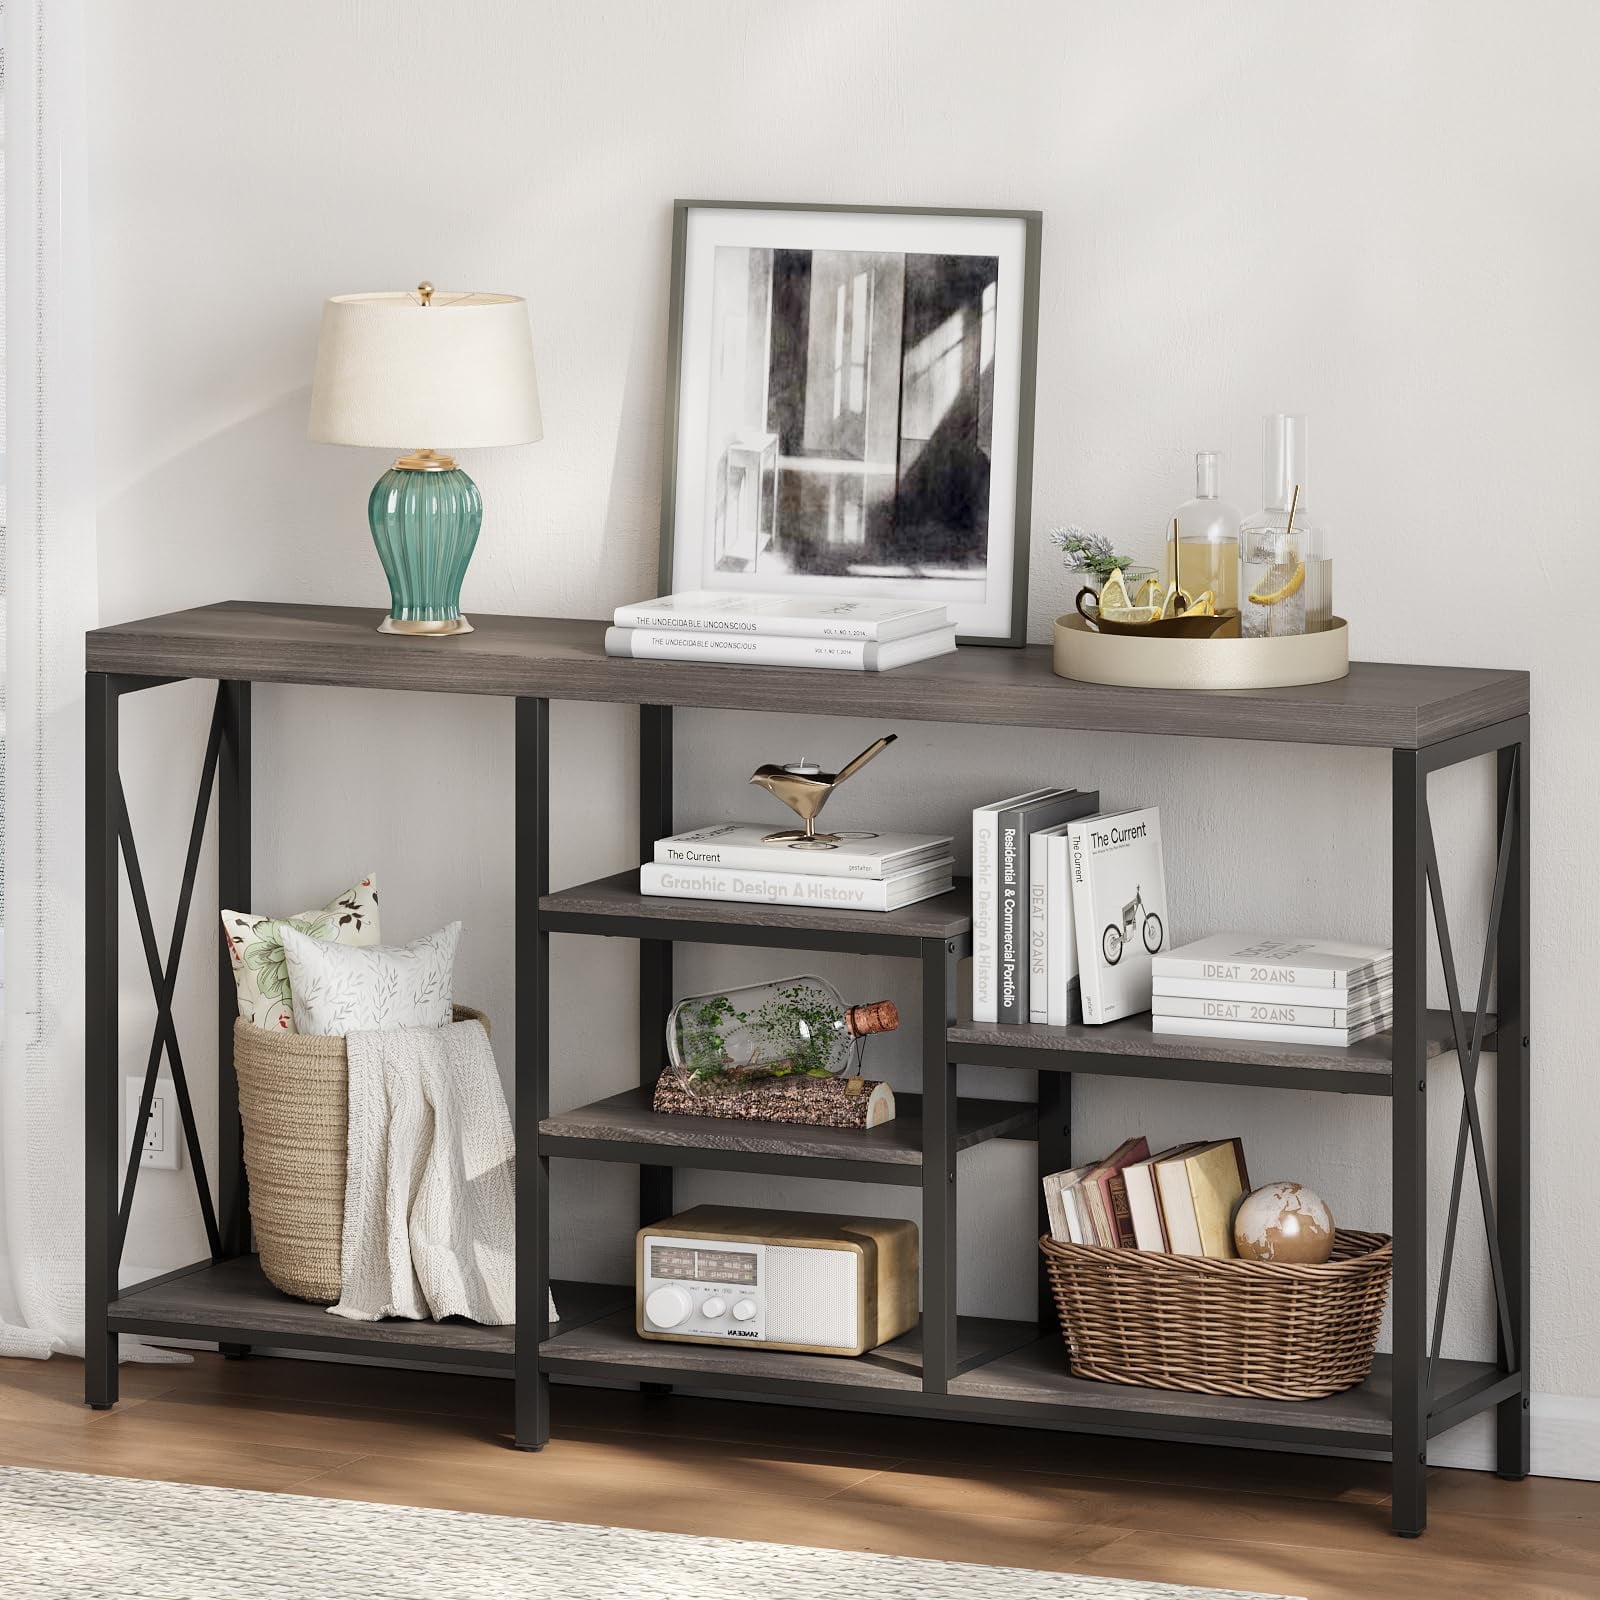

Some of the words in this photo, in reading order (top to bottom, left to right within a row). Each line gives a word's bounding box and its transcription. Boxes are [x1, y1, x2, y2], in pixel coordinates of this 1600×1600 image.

[636, 616, 650, 625] THE
[652, 618, 700, 628] UNDECIDABLE
[703, 620, 757, 631] UNCONSCIOUS
[652, 637, 663, 645] THE
[665, 638, 708, 648] UNDECIDABLE
[710, 640, 757, 650] UNCONSCIOUS
[1072, 835, 1081, 850] The
[1091, 831, 1109, 849] The
[1110, 821, 1147, 844] Current
[667, 849, 684, 860] The
[686, 850, 721, 862] Current
[1004, 828, 1016, 885] Residential
[1073, 852, 1083, 883] Current
[732, 878, 788, 902] Design
[793, 881, 804, 898] A
[808, 884, 865, 902] History
[1004, 888, 1015, 897] &
[1031, 884, 1045, 921] IDEAT
[1003, 898, 1016, 962] Commercial
[1203, 963, 1241, 980] IDEAT
[1003, 963, 1016, 1008] Portfolio
[1203, 1002, 1241, 1019] IDEAT
